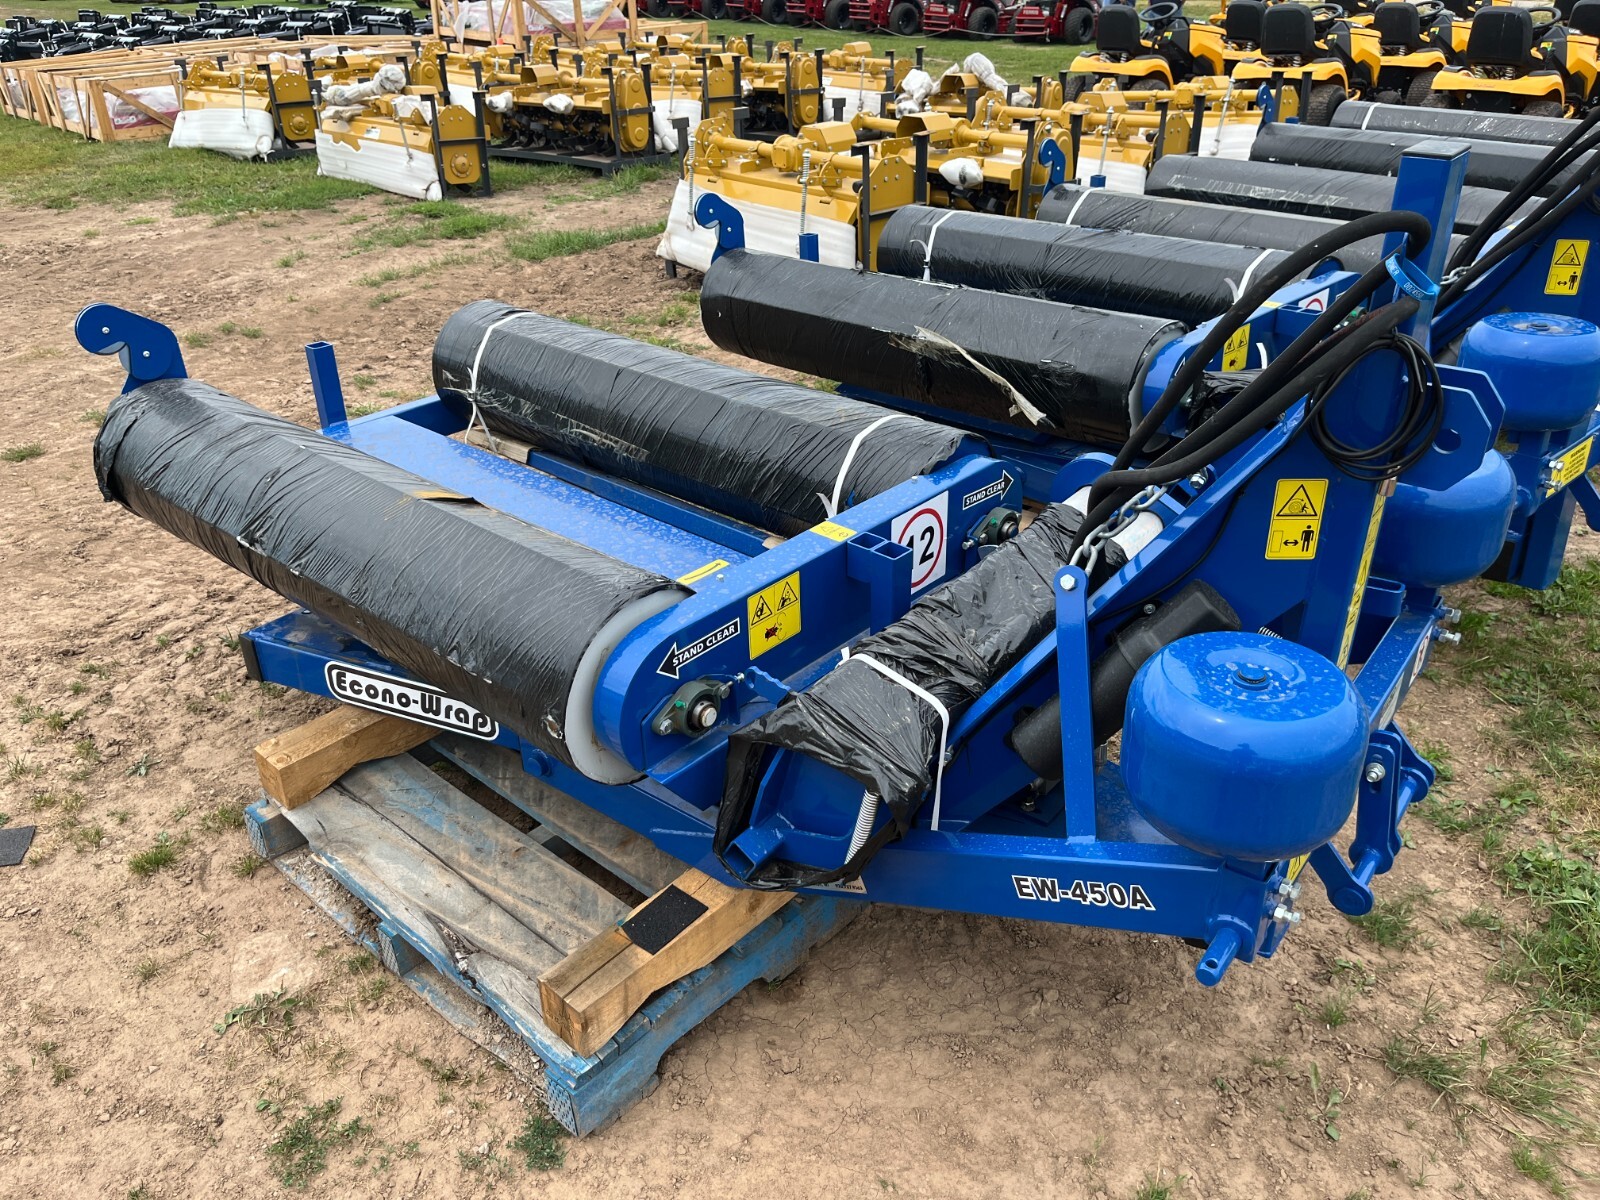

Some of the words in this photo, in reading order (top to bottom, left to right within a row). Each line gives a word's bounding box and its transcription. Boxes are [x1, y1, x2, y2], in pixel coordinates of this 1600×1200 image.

[966, 490, 986, 506] STAND
[986, 480, 1006, 496] CLEAR
[672, 643, 704, 667] STAND
[706, 625, 735, 647] CLEAR
[335, 670, 490, 732] Econo-Wrap
[1011, 874, 1157, 911] EW-450A
